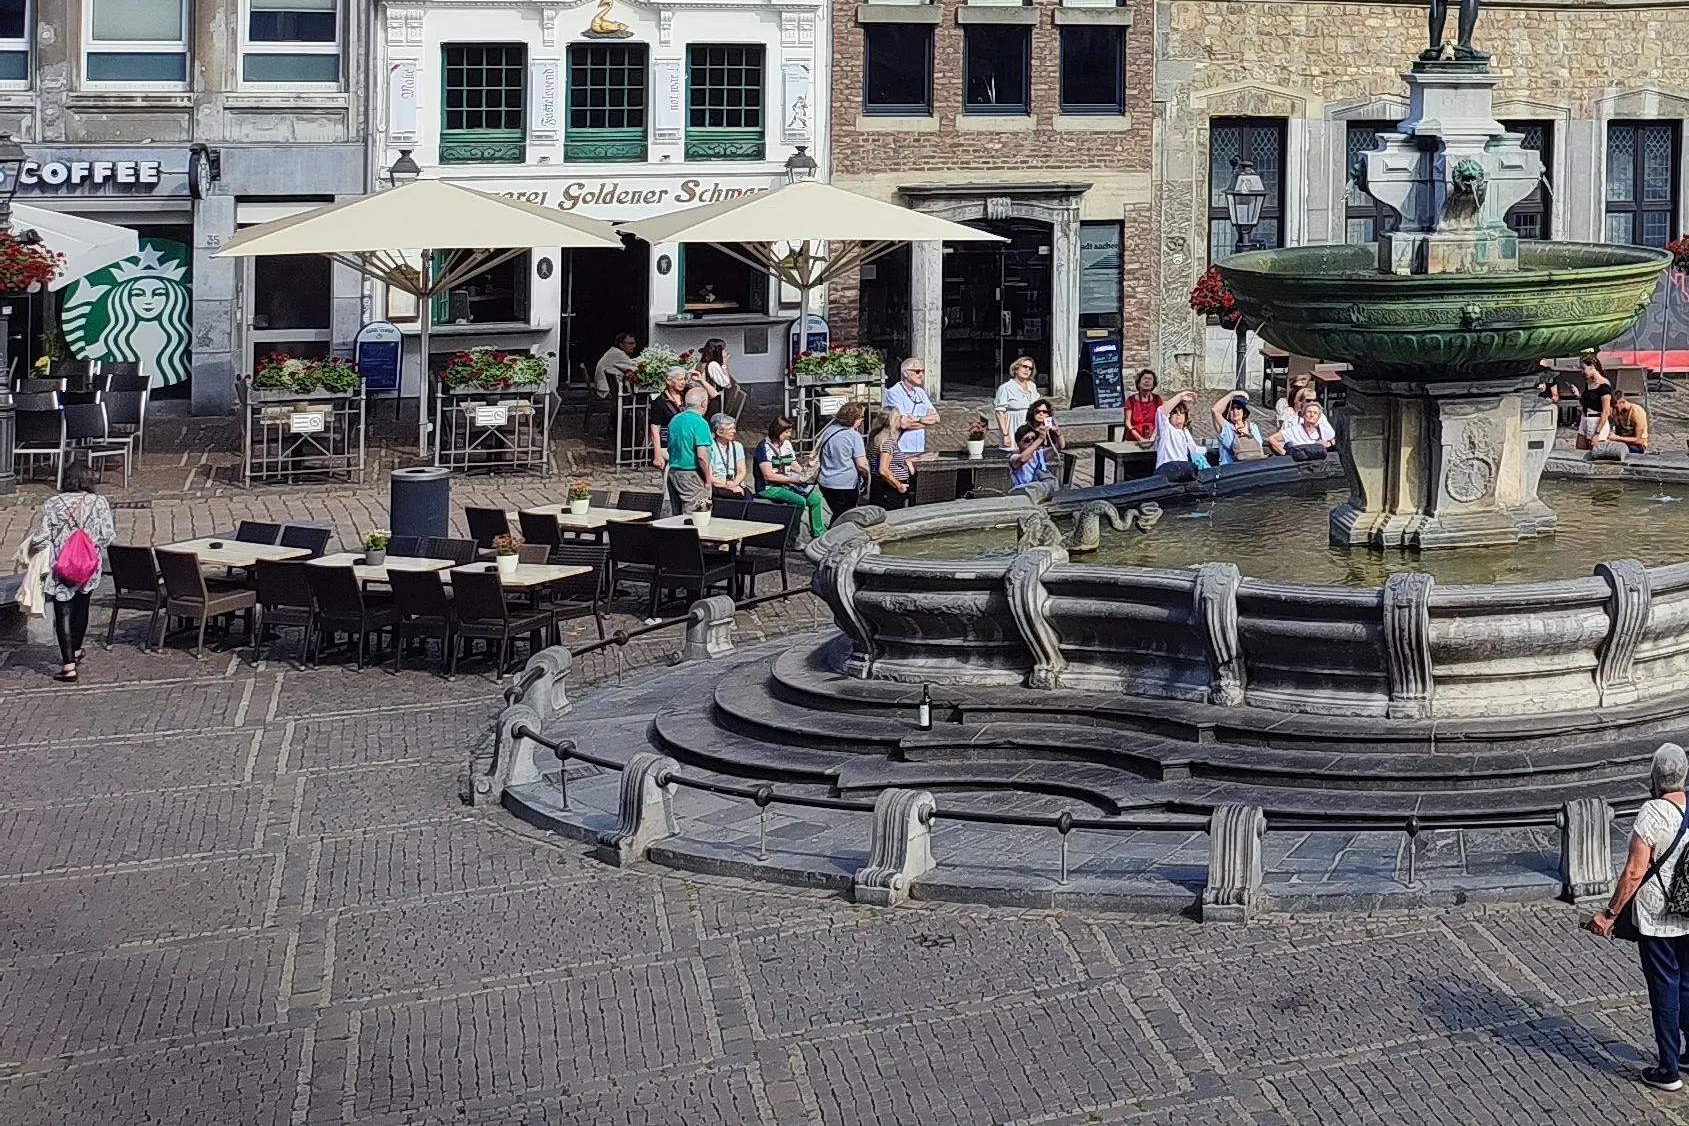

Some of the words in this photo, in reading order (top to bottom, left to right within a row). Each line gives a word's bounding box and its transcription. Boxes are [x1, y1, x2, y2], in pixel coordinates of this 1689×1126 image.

[669, 95, 680, 111] not
[20, 161, 160, 184] COFFEE
[558, 182, 668, 210] Goldener
